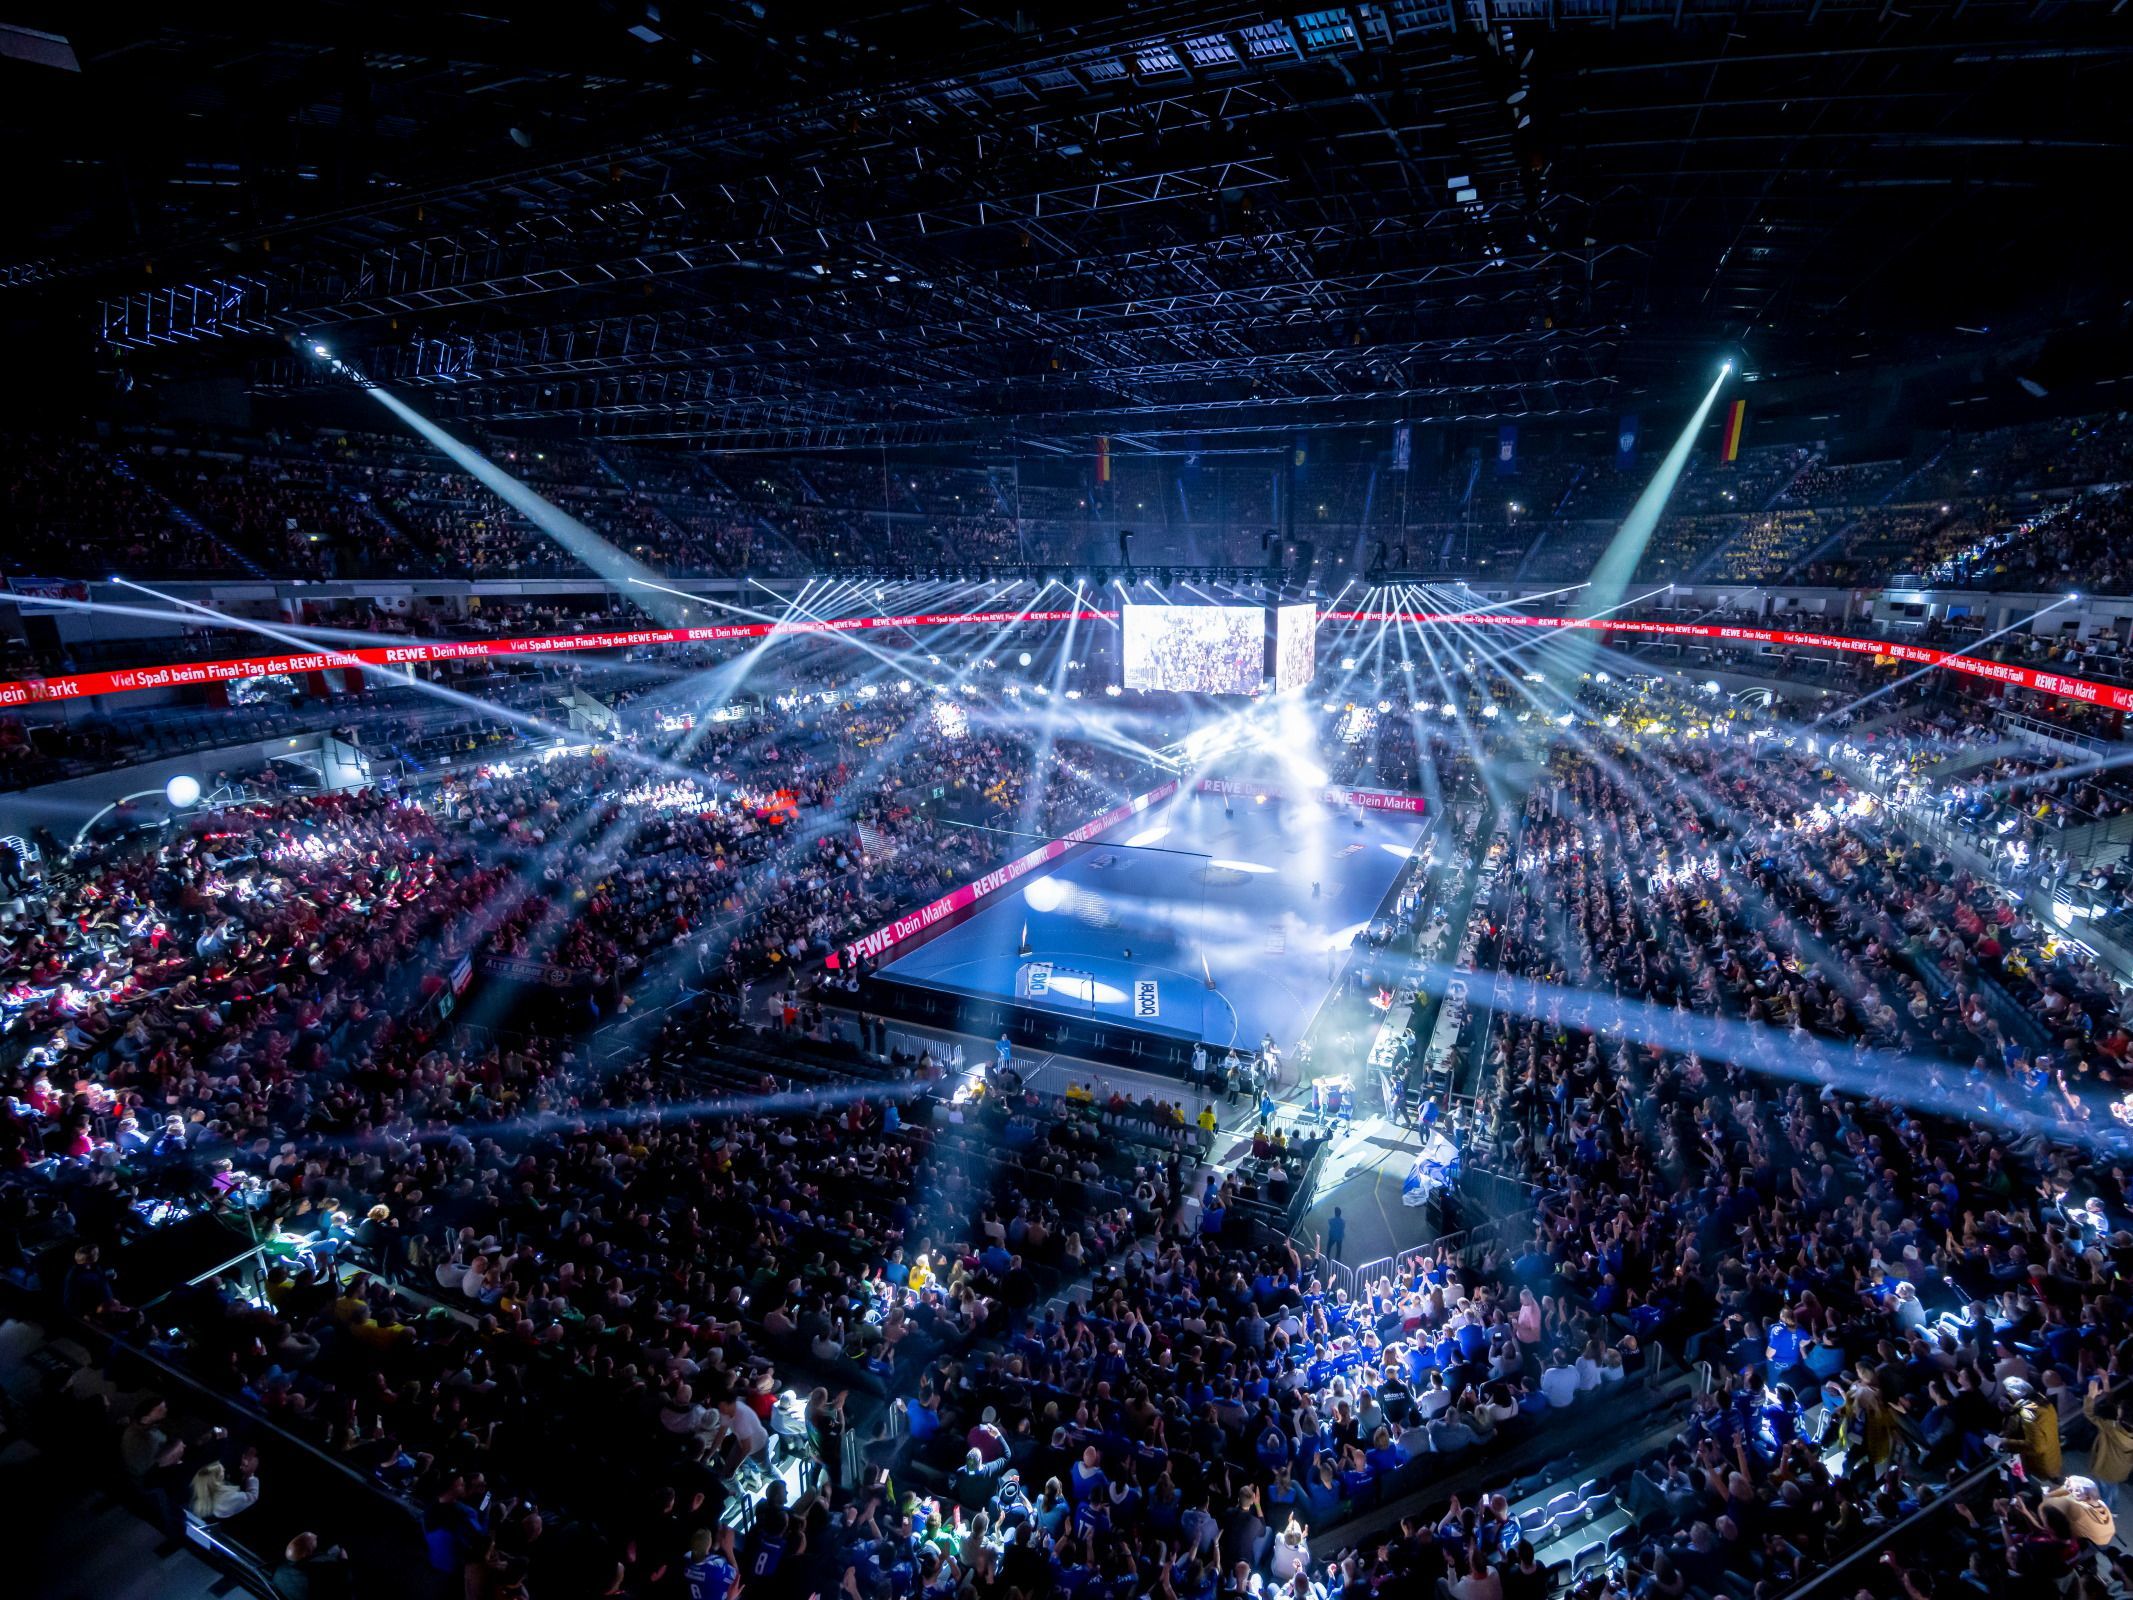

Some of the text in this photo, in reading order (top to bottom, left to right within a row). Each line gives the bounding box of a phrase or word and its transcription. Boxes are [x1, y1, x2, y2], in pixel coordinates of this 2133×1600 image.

[1538, 618, 1559, 626] REWE
[1675, 625, 1691, 633] REWE
[510, 632, 674, 651] Viel Spaß beim Final-Tag des REWE Final4
[688, 627, 751, 639] REWE Dein Markt
[1721, 628, 1771, 640] REWE Dein Markt
[386, 644, 488, 661] REWE Dein Markt
[1890, 645, 1905, 656] REWE
[110, 653, 360, 687] Viel Spaß beim Final-Tag des REWE Final4
[1993, 666, 2008, 678] REWE
[0, 686, 27, 703] ein
[2034, 674, 2096, 700] REWE Dein Markt
[2112, 690, 2127, 706] Viel
[1203, 779, 1241, 793] REWE
[1320, 790, 1354, 804] EWE
[1358, 793, 1381, 807] Dein
[1383, 796, 1416, 810] Markt
[1062, 825, 1089, 849] REWE
[972, 847, 1050, 898] REWE Dein Markt
[846, 899, 953, 968] REWE Dein Markt
[1030, 972, 1048, 991] DKB
[1138, 982, 1156, 1016] brother
